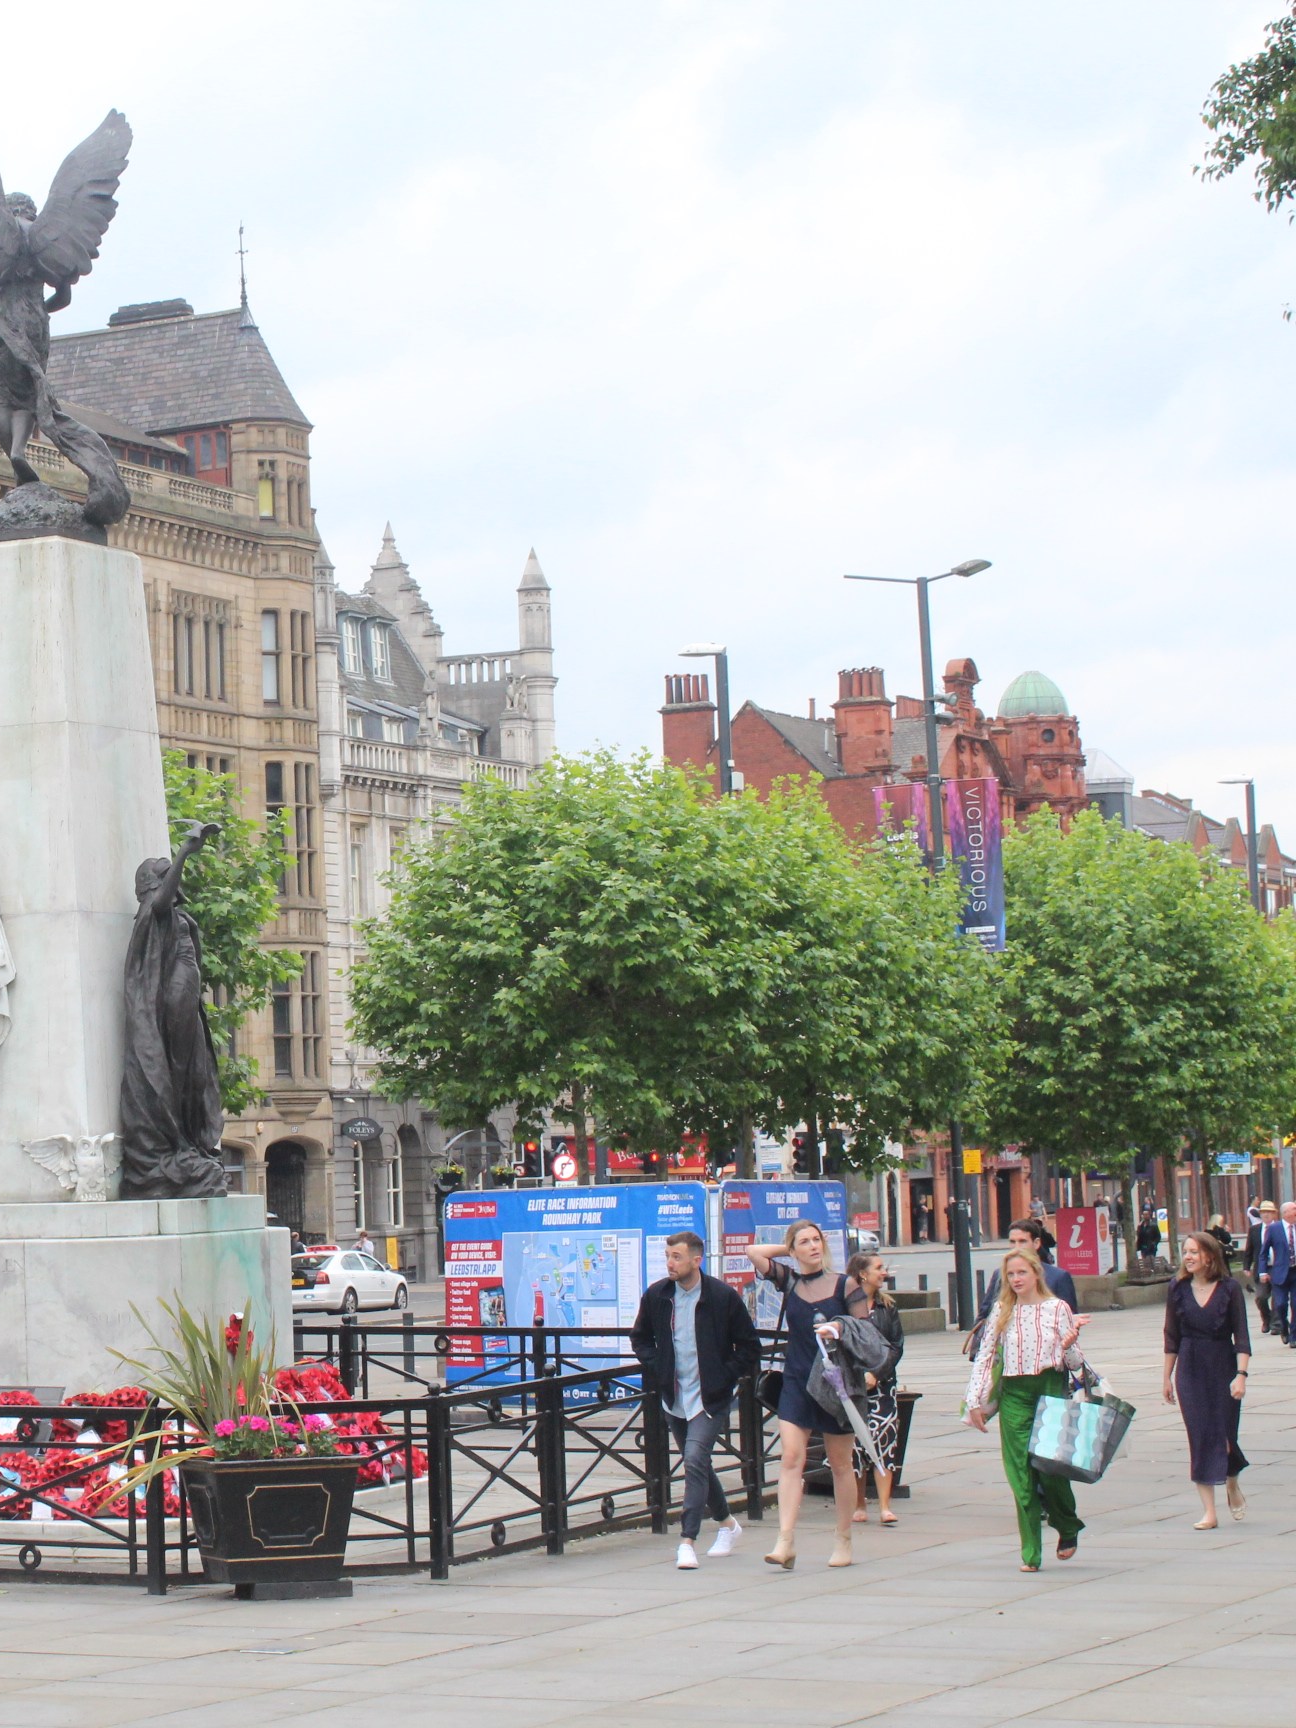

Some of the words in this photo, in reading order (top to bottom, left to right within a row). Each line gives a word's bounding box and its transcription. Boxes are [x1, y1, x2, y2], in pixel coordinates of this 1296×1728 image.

[965, 786, 987, 912] VICTORIOUS
[528, 1199, 546, 1211] ELITE
[547, 1198, 566, 1210] RACE
[566, 1196, 617, 1210] INFORMATION
[658, 1204, 694, 1214] #WTSLeeds
[542, 1213, 581, 1226] ROUNDHAY
[582, 1212, 602, 1224] PARK
[451, 1264, 496, 1275] LEEDSTRI.APP
